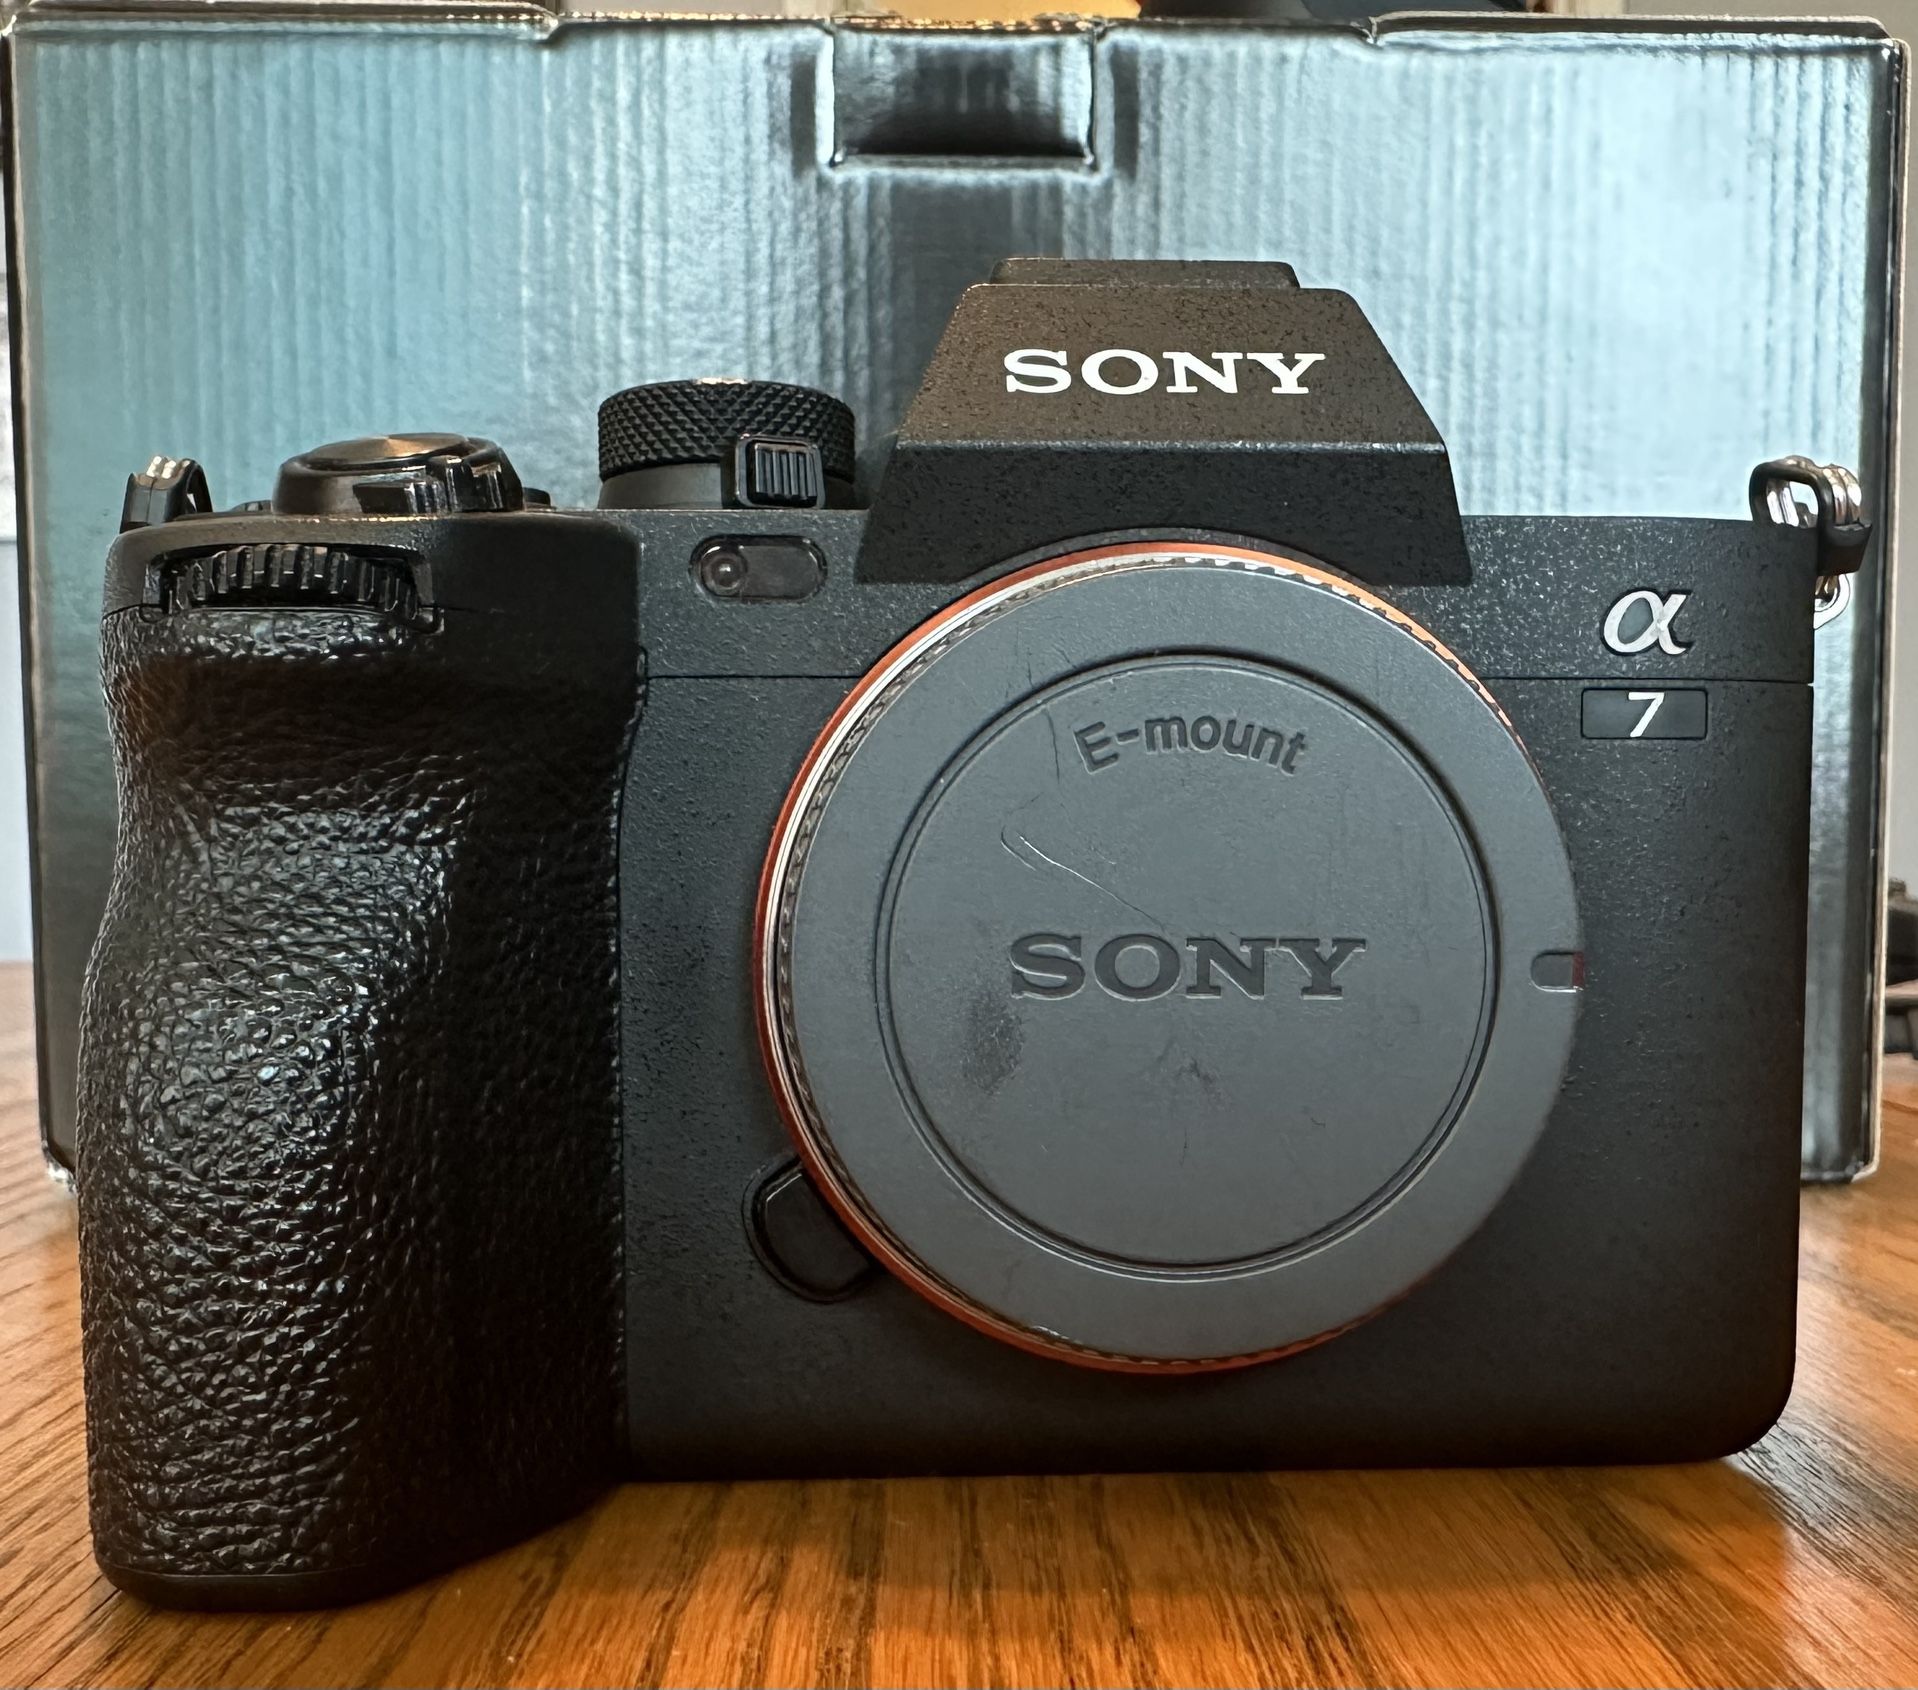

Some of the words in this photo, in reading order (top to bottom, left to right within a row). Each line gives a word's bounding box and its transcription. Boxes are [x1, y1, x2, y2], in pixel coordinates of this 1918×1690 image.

[1003, 348, 1326, 395] SONY
[1628, 691, 1665, 738] 7
[1074, 714, 1308, 776] E-mount
[1009, 933, 1367, 1002] SONY
